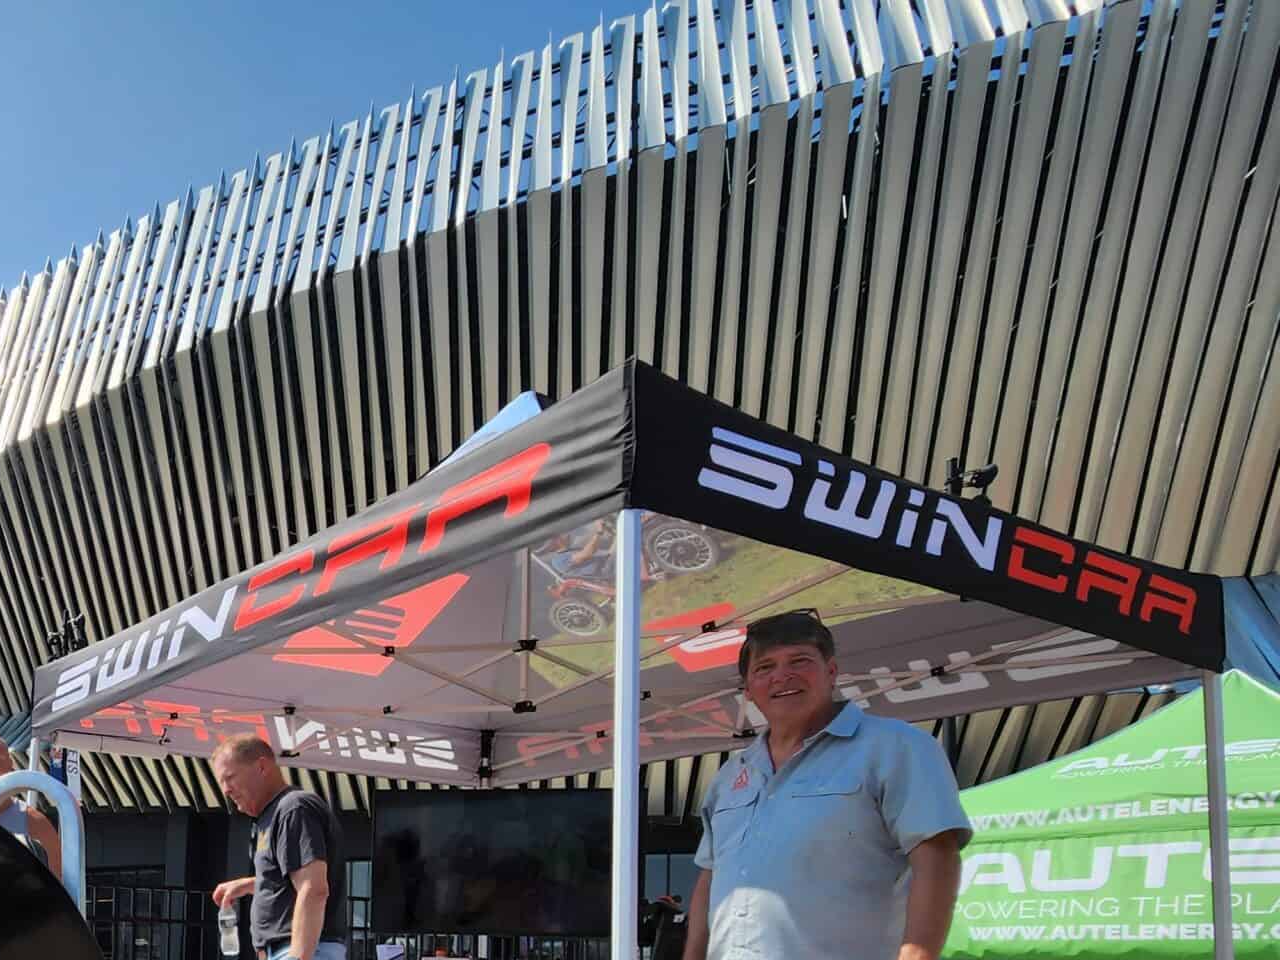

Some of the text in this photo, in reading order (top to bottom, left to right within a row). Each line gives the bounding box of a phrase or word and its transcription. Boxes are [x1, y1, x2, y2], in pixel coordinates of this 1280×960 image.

[51, 442, 552, 713] SWINCAR
[696, 425, 1198, 636] SWINCAR
[968, 790, 1280, 832] WWW.AUTELENEGY
[1130, 894, 1206, 917] THE
